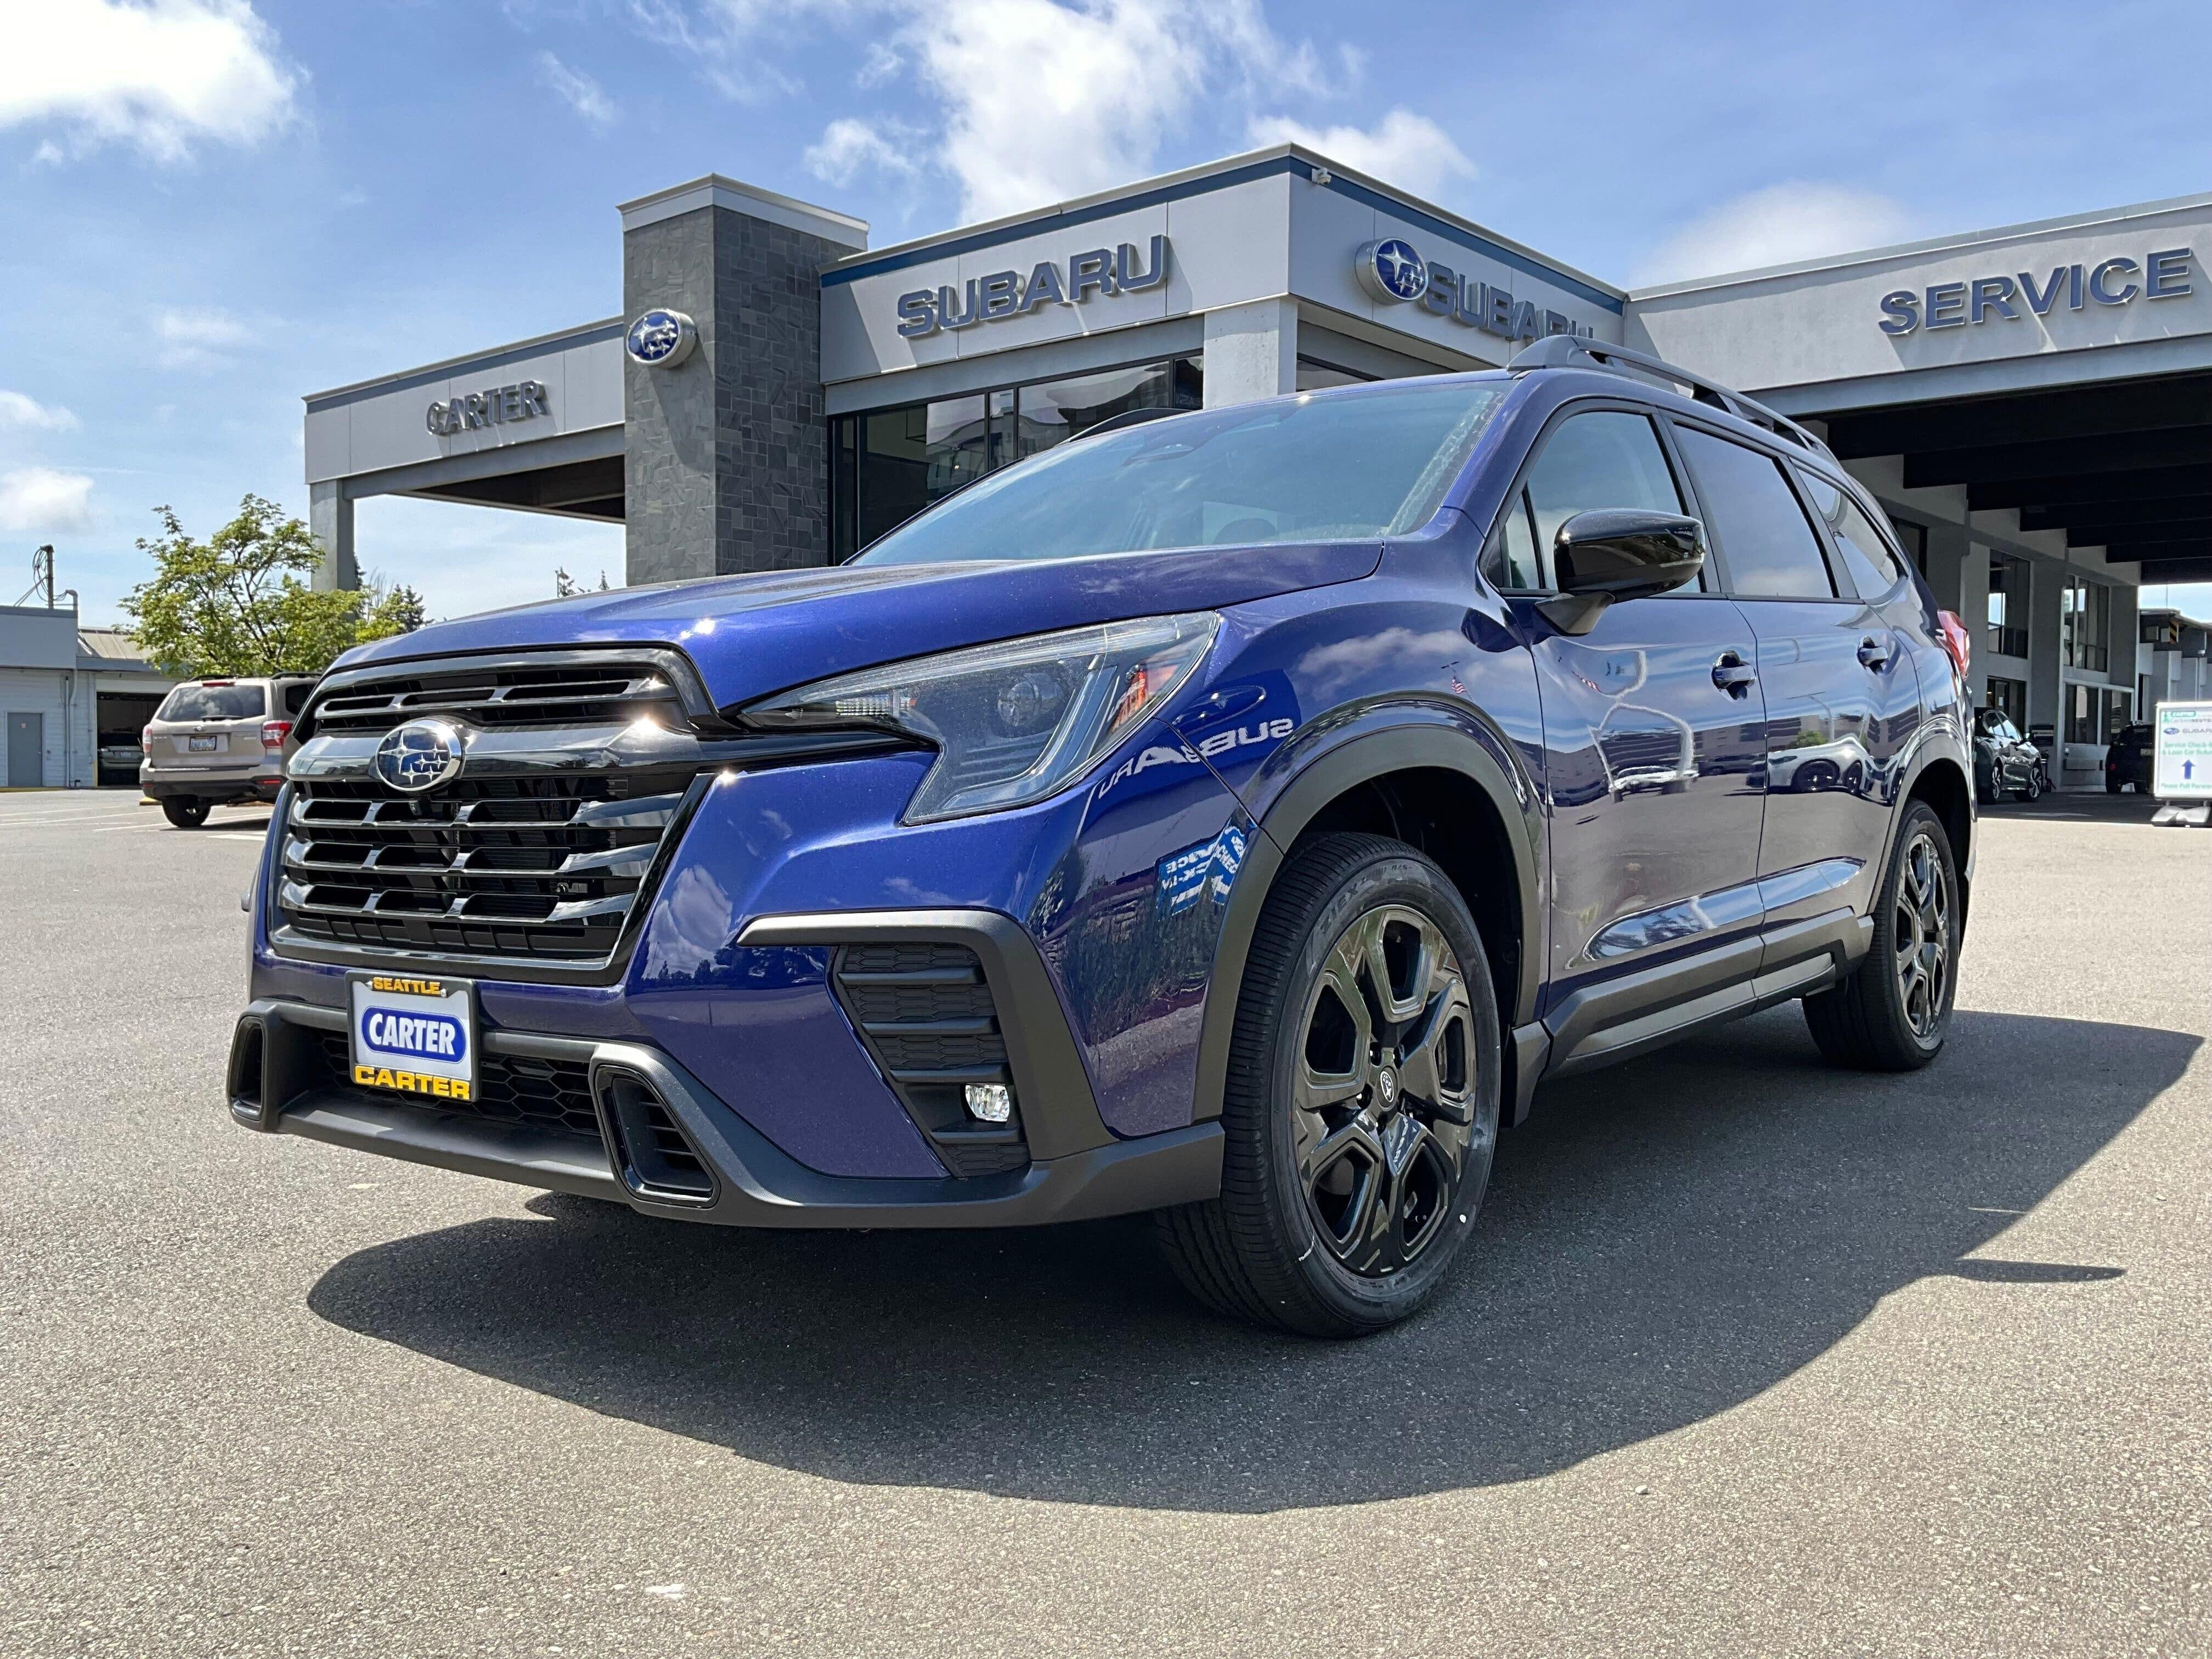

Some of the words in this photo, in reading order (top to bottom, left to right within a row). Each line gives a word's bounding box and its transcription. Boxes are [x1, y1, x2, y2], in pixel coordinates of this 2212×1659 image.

[897, 234, 1170, 338] SUBARU
[1878, 247, 2194, 335] SERVICE
[426, 380, 545, 433] CARTER
[373, 977, 441, 995] SEATTLE
[369, 1013, 455, 1055] CARTER
[354, 1065, 470, 1100] CARTER
